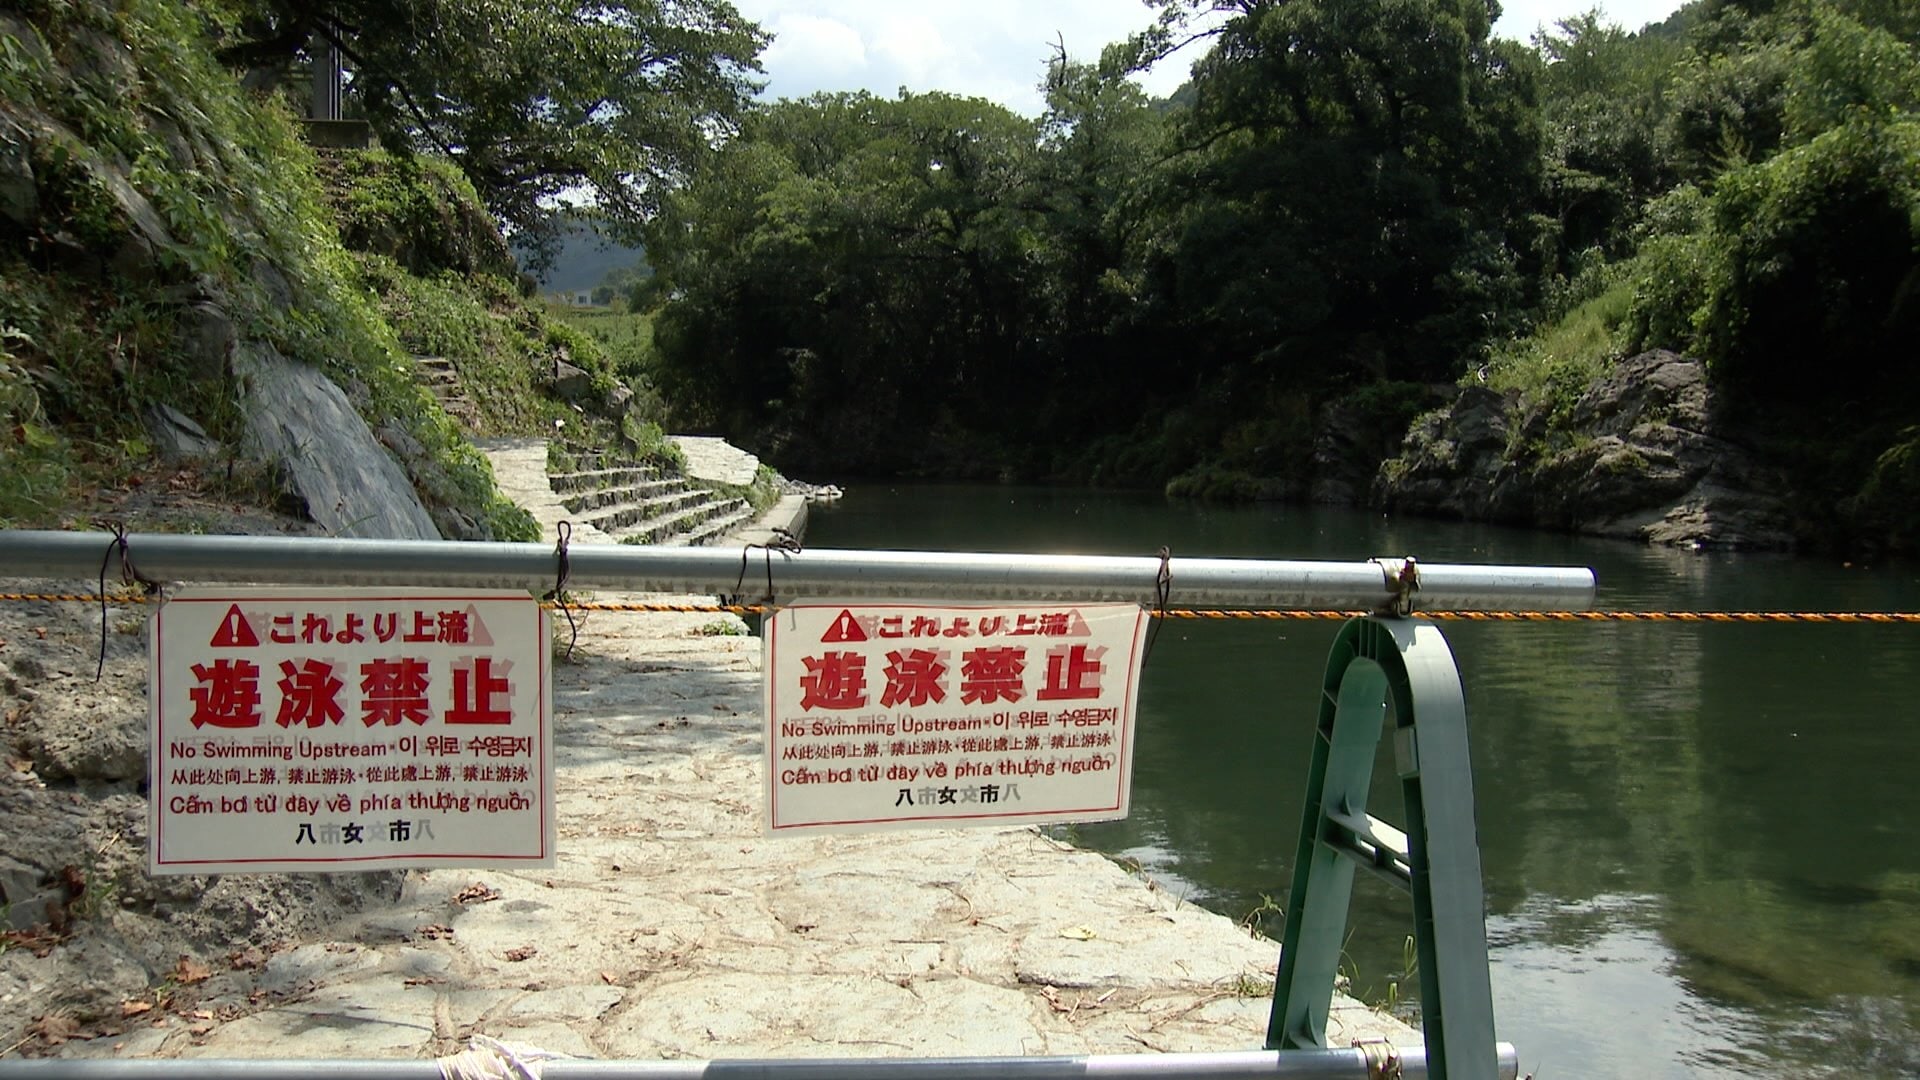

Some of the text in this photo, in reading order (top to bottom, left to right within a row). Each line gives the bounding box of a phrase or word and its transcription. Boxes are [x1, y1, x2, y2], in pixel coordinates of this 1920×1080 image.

[270, 610, 469, 643] これより上流
[878, 613, 1070, 639] これより上流
[799, 645, 1102, 712] 遊泳禁止
[189, 658, 512, 729] 遊泳禁止
[781, 722, 805, 738] No
[811, 720, 896, 737] Swimming
[1016, 710, 1050, 729] 위로
[1056, 707, 1117, 728] 수영금지
[170, 742, 196, 759] No
[203, 740, 293, 761] Swimming
[425, 735, 461, 757] 위로
[467, 735, 532, 758] 수영금지
[886, 765, 919, 782] đây
[955, 761, 993, 780] phía
[285, 794, 320, 816] đây
[359, 793, 401, 815] phía
